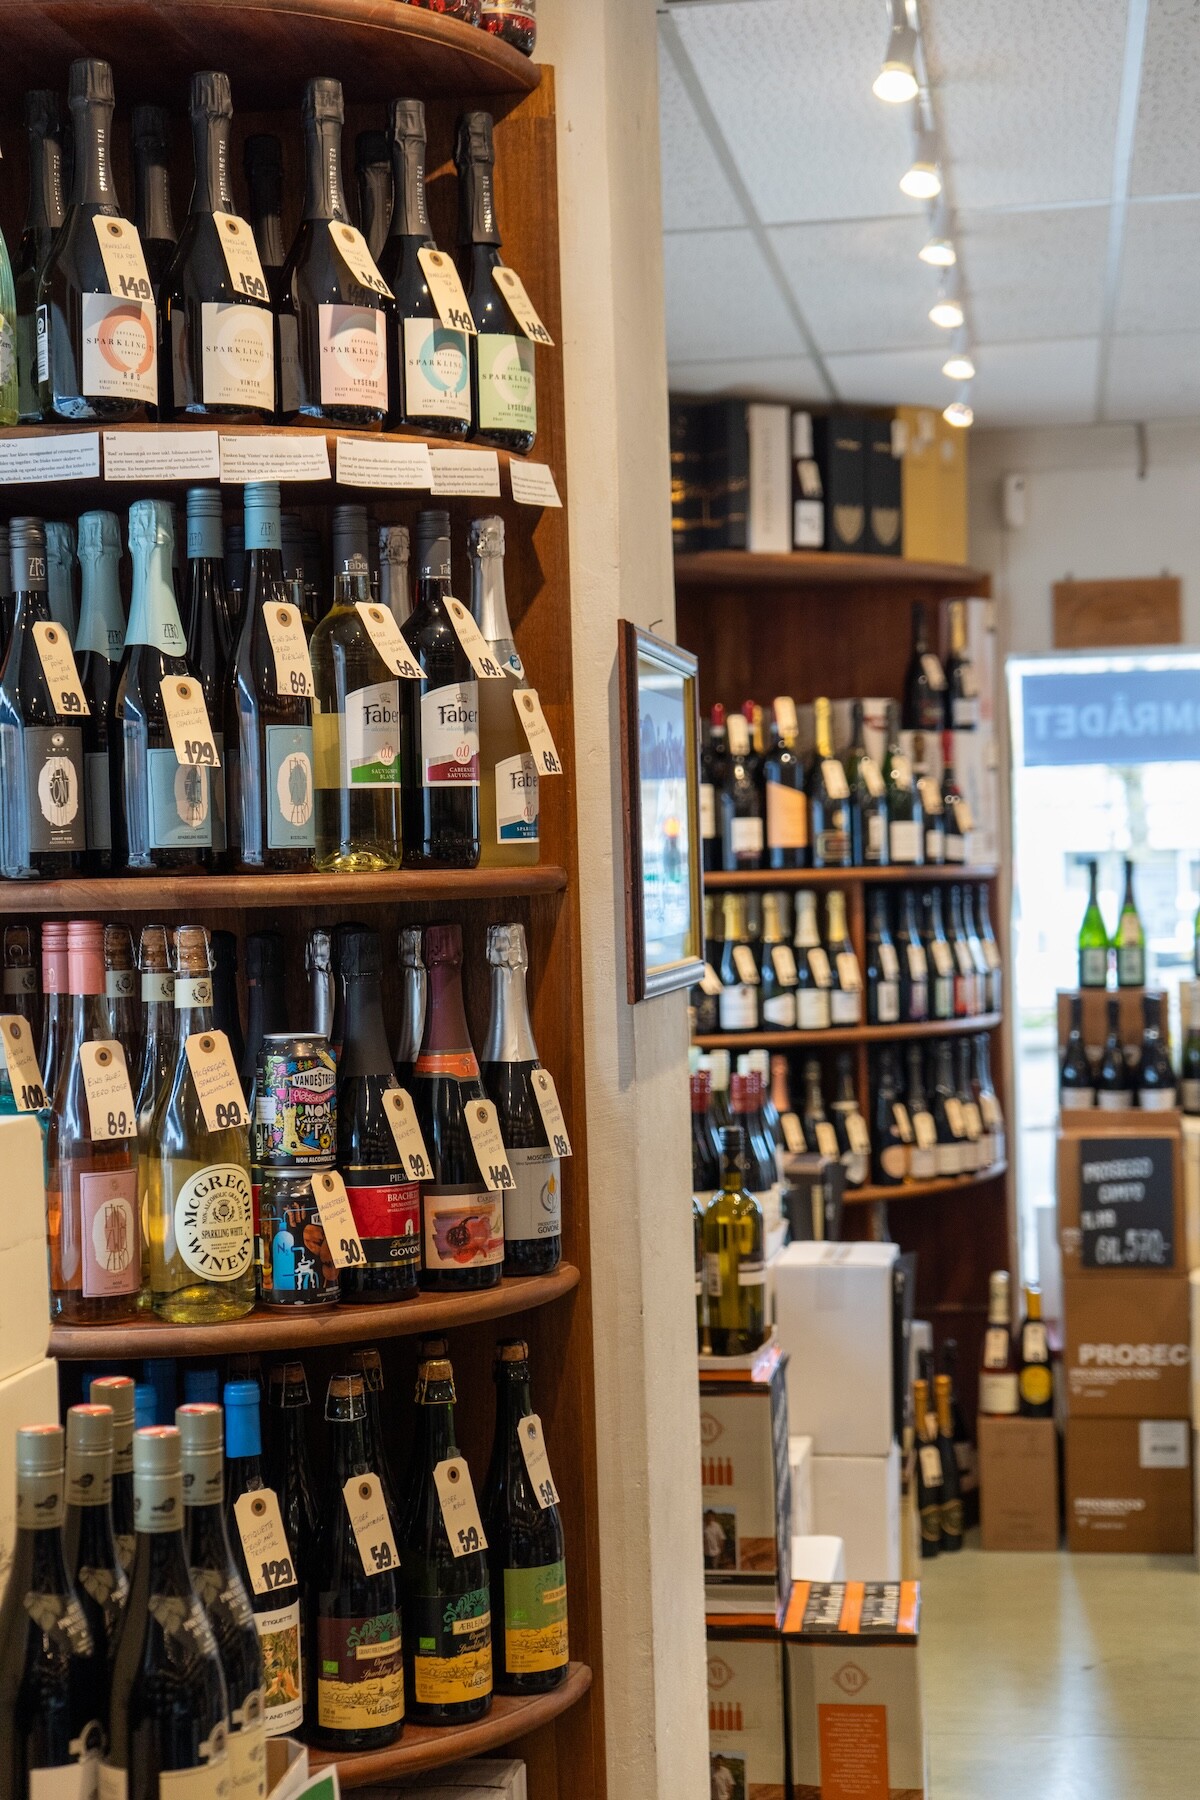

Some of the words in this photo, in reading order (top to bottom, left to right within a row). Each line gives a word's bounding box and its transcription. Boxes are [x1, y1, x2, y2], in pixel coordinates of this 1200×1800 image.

[97, 129, 105, 144] TEA
[86, 338, 146, 349] SPARKLING
[206, 346, 264, 357] SPARKLING
[324, 347, 379, 356] SPARKLING
[409, 360, 462, 368] SPARKLING
[482, 374, 530, 383] SPARKLING
[260, 521, 277, 537] ZERO
[28, 557, 45, 577] ZP5
[162, 623, 179, 639] ZERO
[437, 704, 477, 725] Faber
[199, 1071, 230, 1088] SPARKLING
[305, 1102, 331, 1118] NON
[202, 1228, 229, 1239] SPARKLING
[230, 1227, 243, 1236] WHITE
[538, 1224, 559, 1234] GOVONE
[188, 1232, 251, 1271] WINERY
[262, 1614, 292, 1627] ÉTIQUETTE
[269, 1711, 283, 1721] AND
